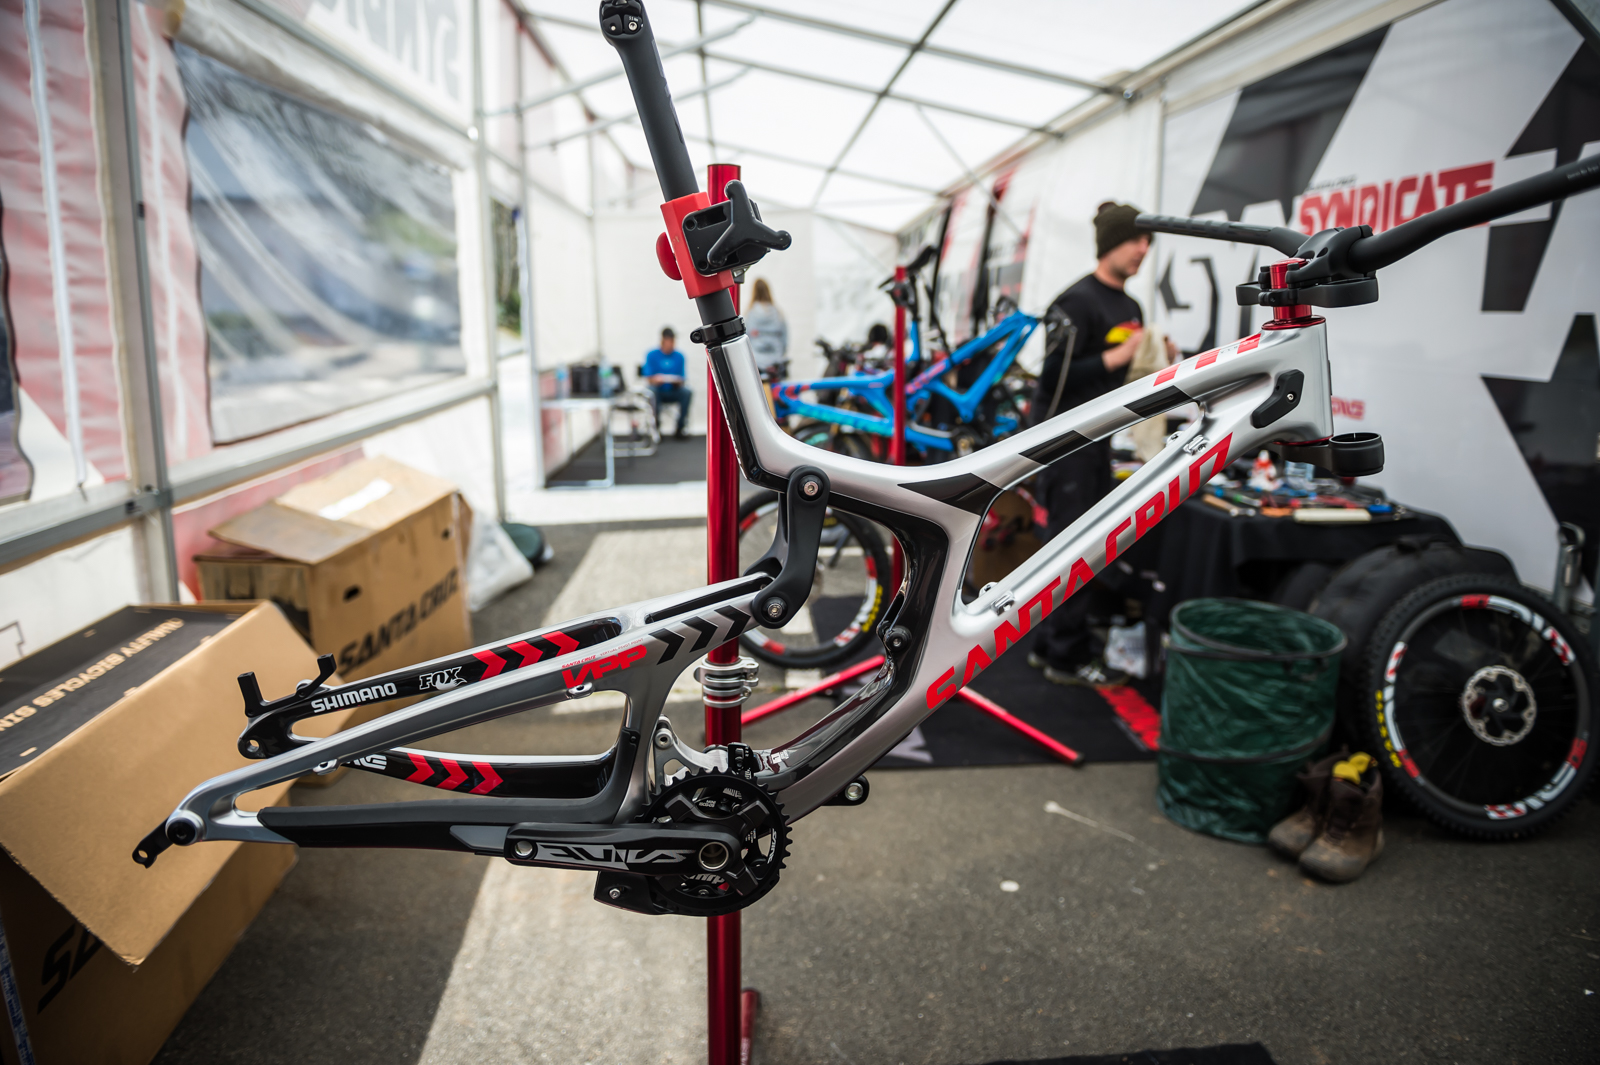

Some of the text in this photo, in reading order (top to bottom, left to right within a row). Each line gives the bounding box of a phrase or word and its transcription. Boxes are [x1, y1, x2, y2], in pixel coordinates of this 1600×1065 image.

[1298, 160, 1495, 237] SYNDICATE
[339, 602, 417, 678] SANTA
[926, 556, 1095, 710] SANTA
[32, 652, 126, 707] BICYCLES
[419, 666, 467, 691] FOX
[561, 644, 648, 689] VPP
[311, 682, 398, 713] SHIMANO
